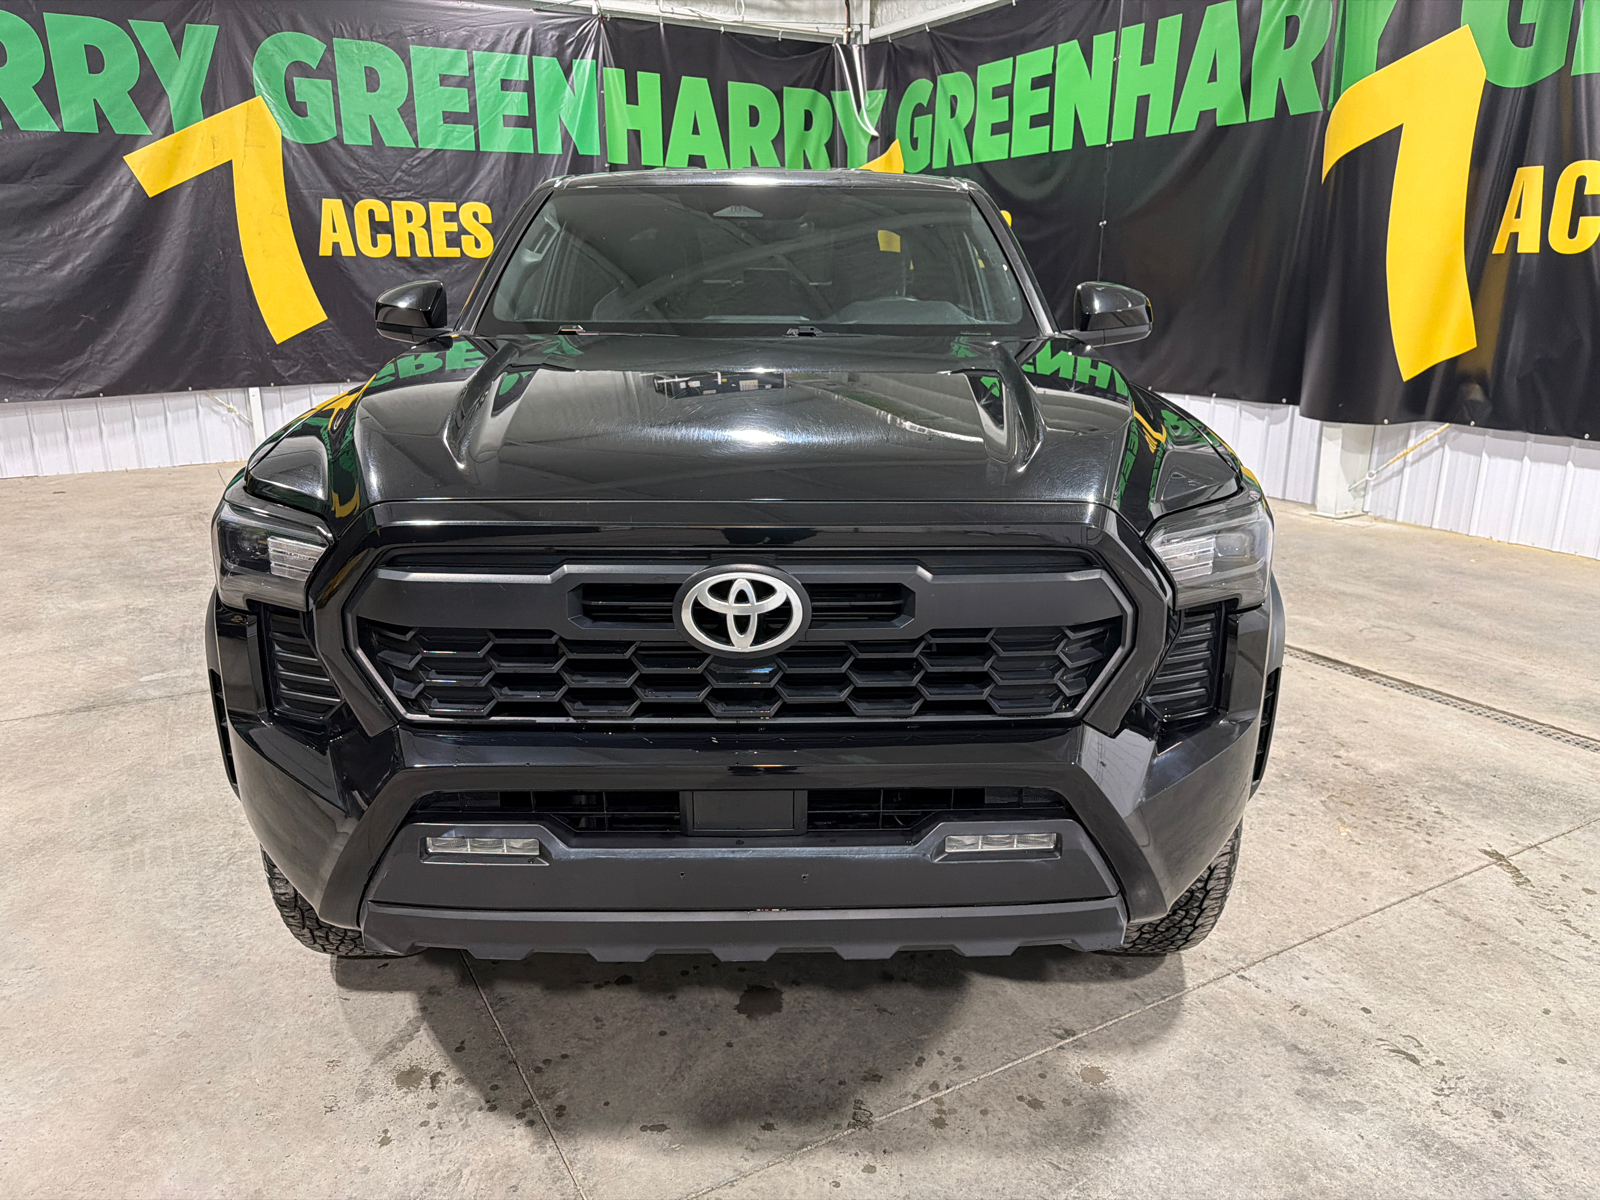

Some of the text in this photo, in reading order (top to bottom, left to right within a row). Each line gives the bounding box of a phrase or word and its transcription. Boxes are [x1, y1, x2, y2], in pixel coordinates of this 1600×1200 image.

[253, 31, 599, 157] GREEN
[603, 30, 1117, 175] HARRY GREEN
[123, 96, 495, 345] 7 ACRES
[1322, 24, 1600, 382] 7 AC
